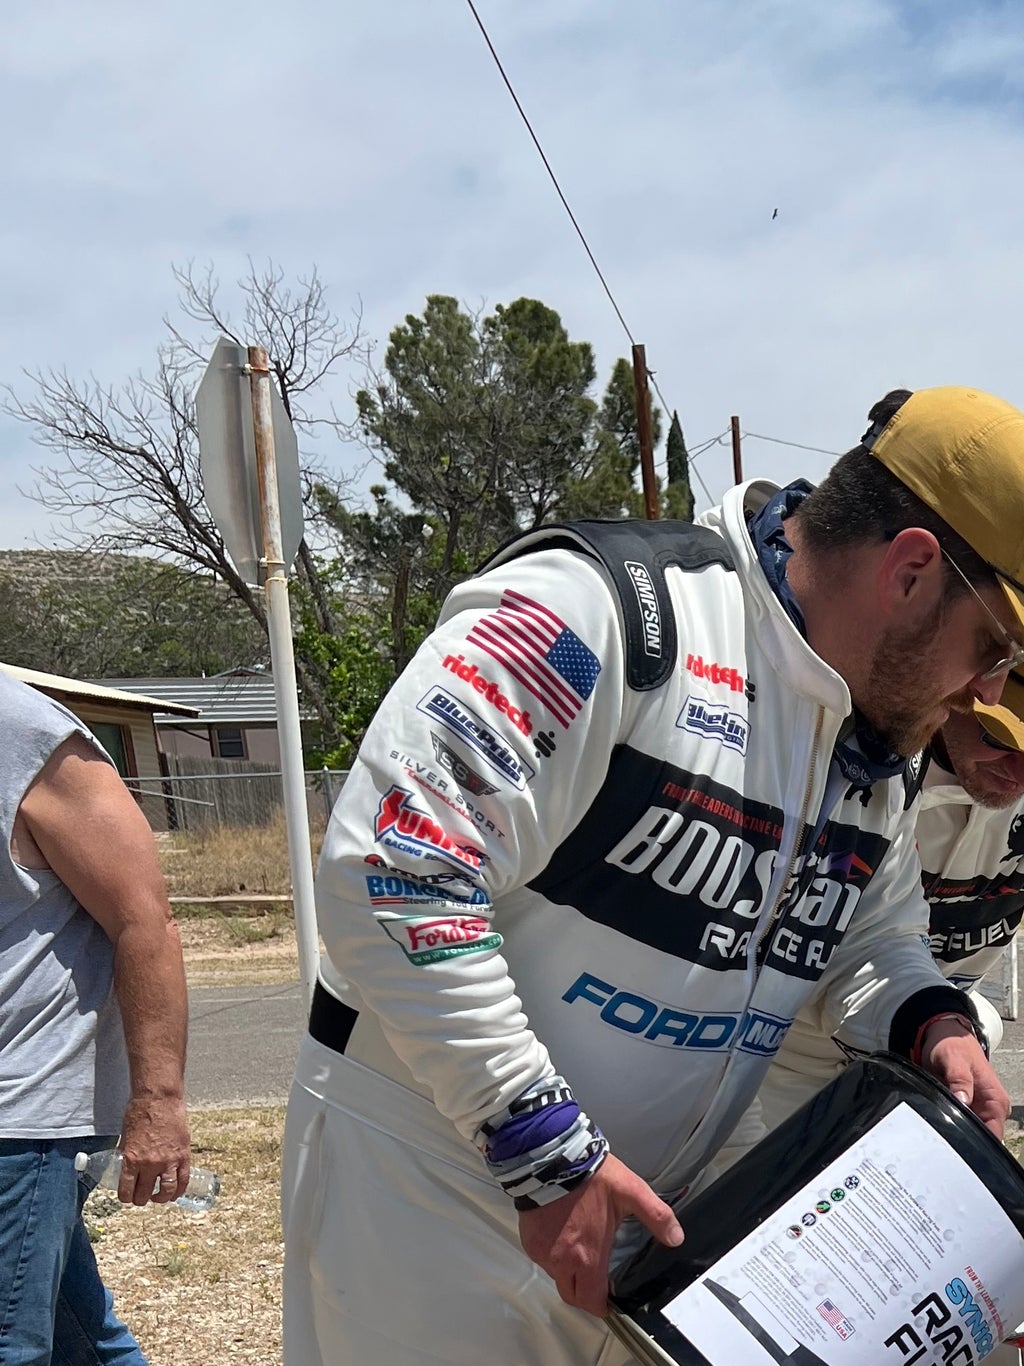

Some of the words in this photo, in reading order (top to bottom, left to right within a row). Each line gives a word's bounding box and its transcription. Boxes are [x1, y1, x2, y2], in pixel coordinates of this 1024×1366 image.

[629, 566, 661, 649] SIMPSON
[431, 693, 524, 777] BluePrint
[442, 654, 533, 737] ridetech
[389, 750, 449, 791] SILVER
[456, 793, 506, 838] SPORT
[384, 837, 422, 857] RACING
[561, 971, 738, 1048] FORD
[964, 1265, 978, 1282] FROM
[835, 1324, 848, 1339] USA
